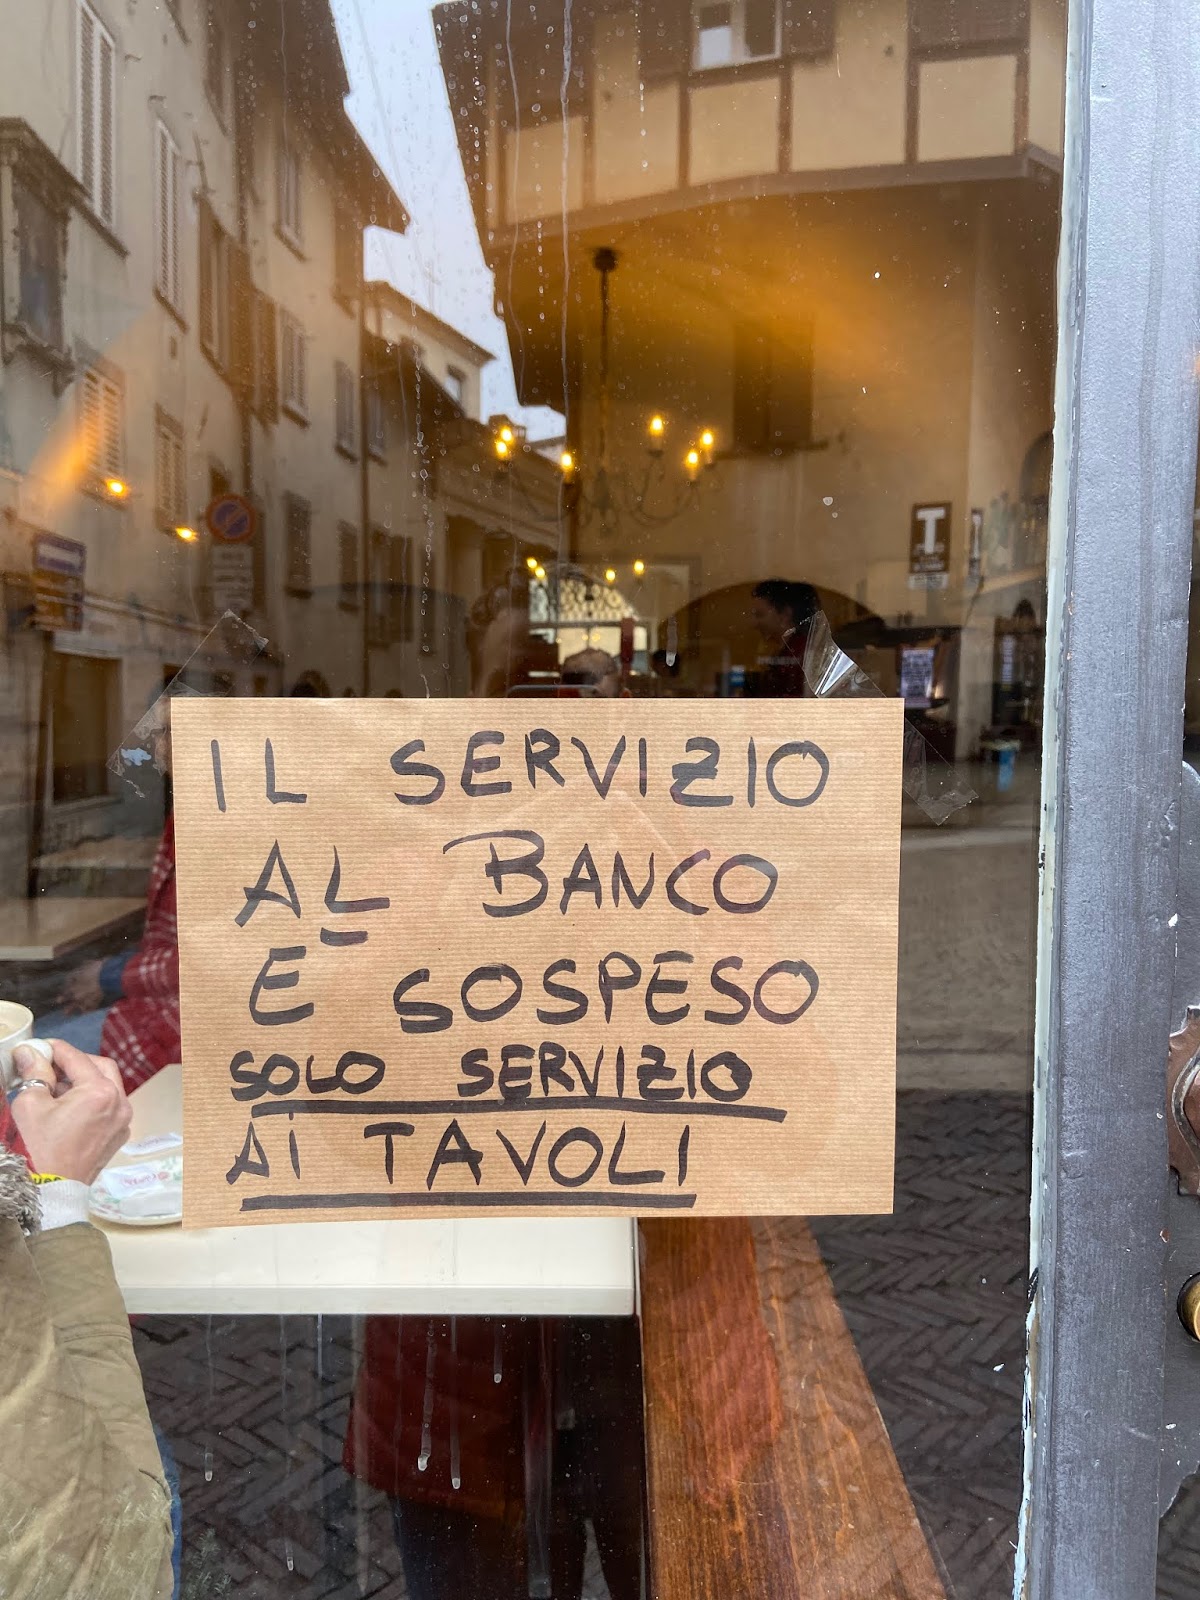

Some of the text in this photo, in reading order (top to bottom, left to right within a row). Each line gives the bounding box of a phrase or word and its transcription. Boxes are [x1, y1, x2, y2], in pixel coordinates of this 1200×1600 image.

[210, 728, 830, 813] IL SERVIZIO
[234, 829, 779, 927] AL BANCO
[393, 950, 820, 1034] SOSPESO
[229, 1041, 753, 1102] SOLO SERVIZIO
[364, 1119, 690, 1191] TAVOLI
